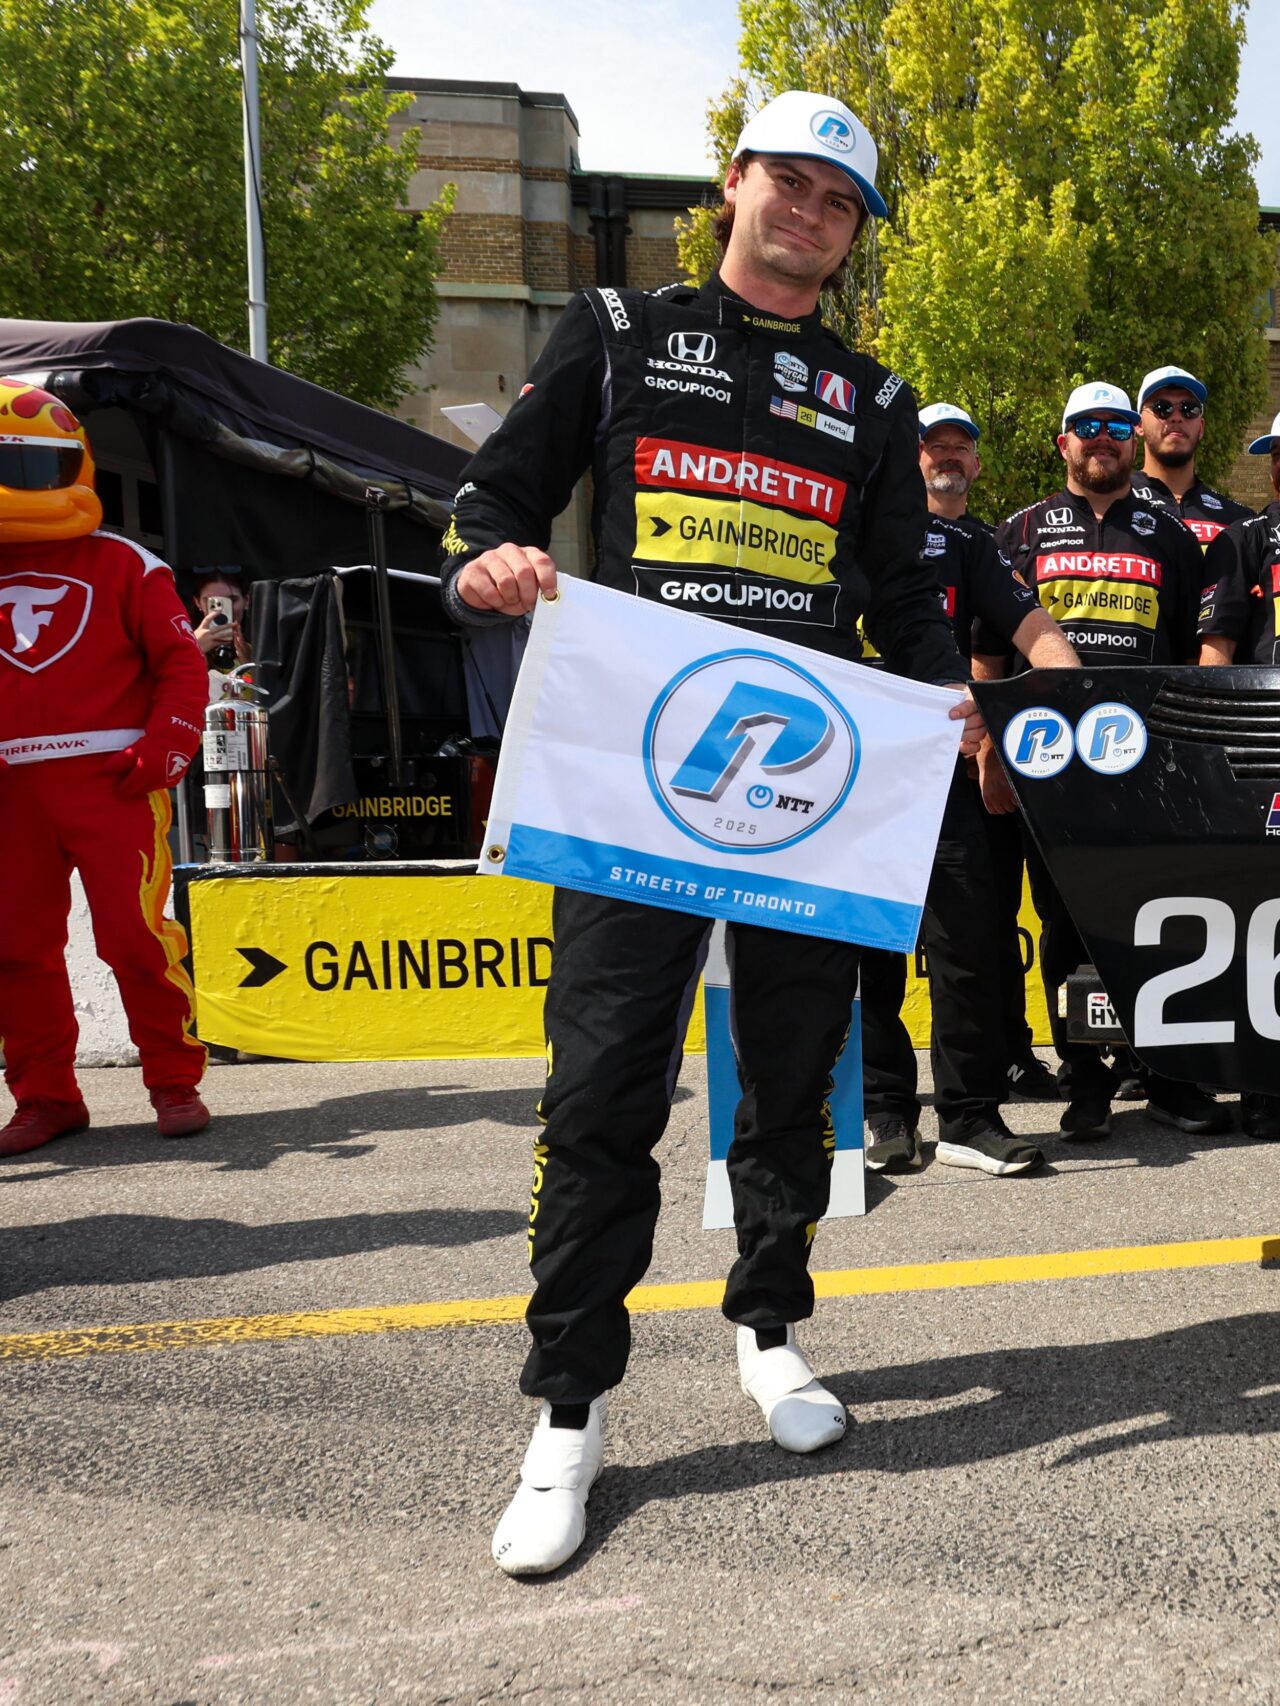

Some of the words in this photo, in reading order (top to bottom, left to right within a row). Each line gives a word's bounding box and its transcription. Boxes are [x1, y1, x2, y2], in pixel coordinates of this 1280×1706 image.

[753, 316, 801, 333] GAINBRIDGE
[647, 357, 733, 382] HONDA
[774, 363, 809, 383] INDYCAR
[645, 375, 732, 404] GROUP1001
[801, 411, 812, 422] 26
[824, 421, 846, 435] Herta
[651, 448, 833, 513] ANDRETTI
[680, 515, 825, 566] GAINBRIDGE
[1037, 526, 1085, 534] HONDA
[1040, 538, 1084, 548] GROUP1001
[1044, 554, 1156, 579] ANDRETTI
[660, 581, 813, 612] GROUP1001
[1064, 592, 1152, 615] GAINBRIDGE
[1065, 632, 1137, 648] ROUP1001
[331, 796, 452, 818] GAINBRIDGE
[775, 794, 815, 814] NTT
[713, 817, 758, 836] 2025
[610, 866, 698, 897] STREETS
[704, 887, 726, 902] OF
[732, 890, 816, 918] TORONTO
